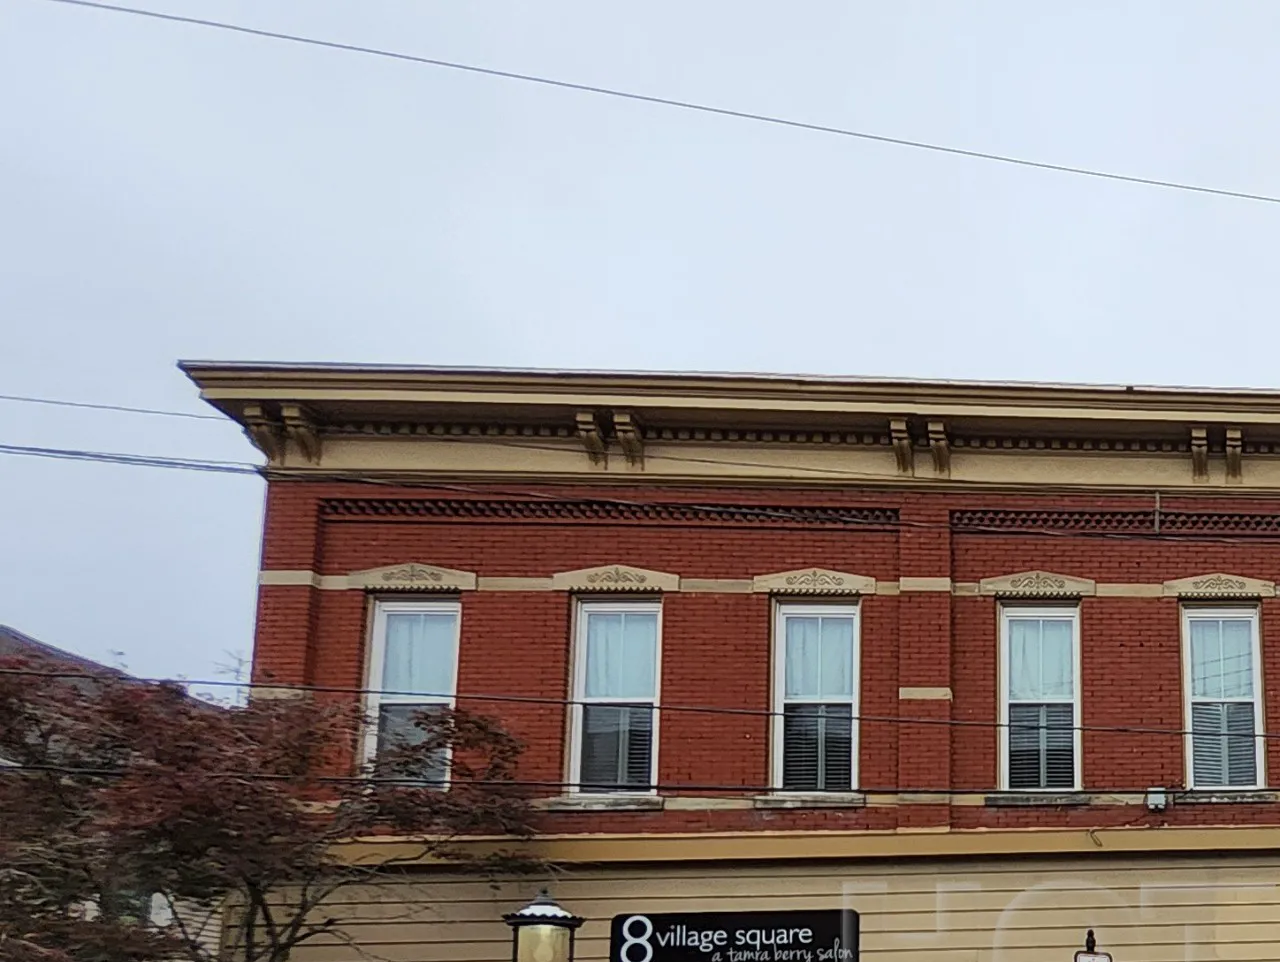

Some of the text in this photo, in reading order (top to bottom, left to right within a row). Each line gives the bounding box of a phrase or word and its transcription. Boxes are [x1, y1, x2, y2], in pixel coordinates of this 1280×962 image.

[656, 924, 729, 953] village
[734, 928, 814, 951] square
[711, 953, 724, 962] a
[816, 937, 854, 962] salon
